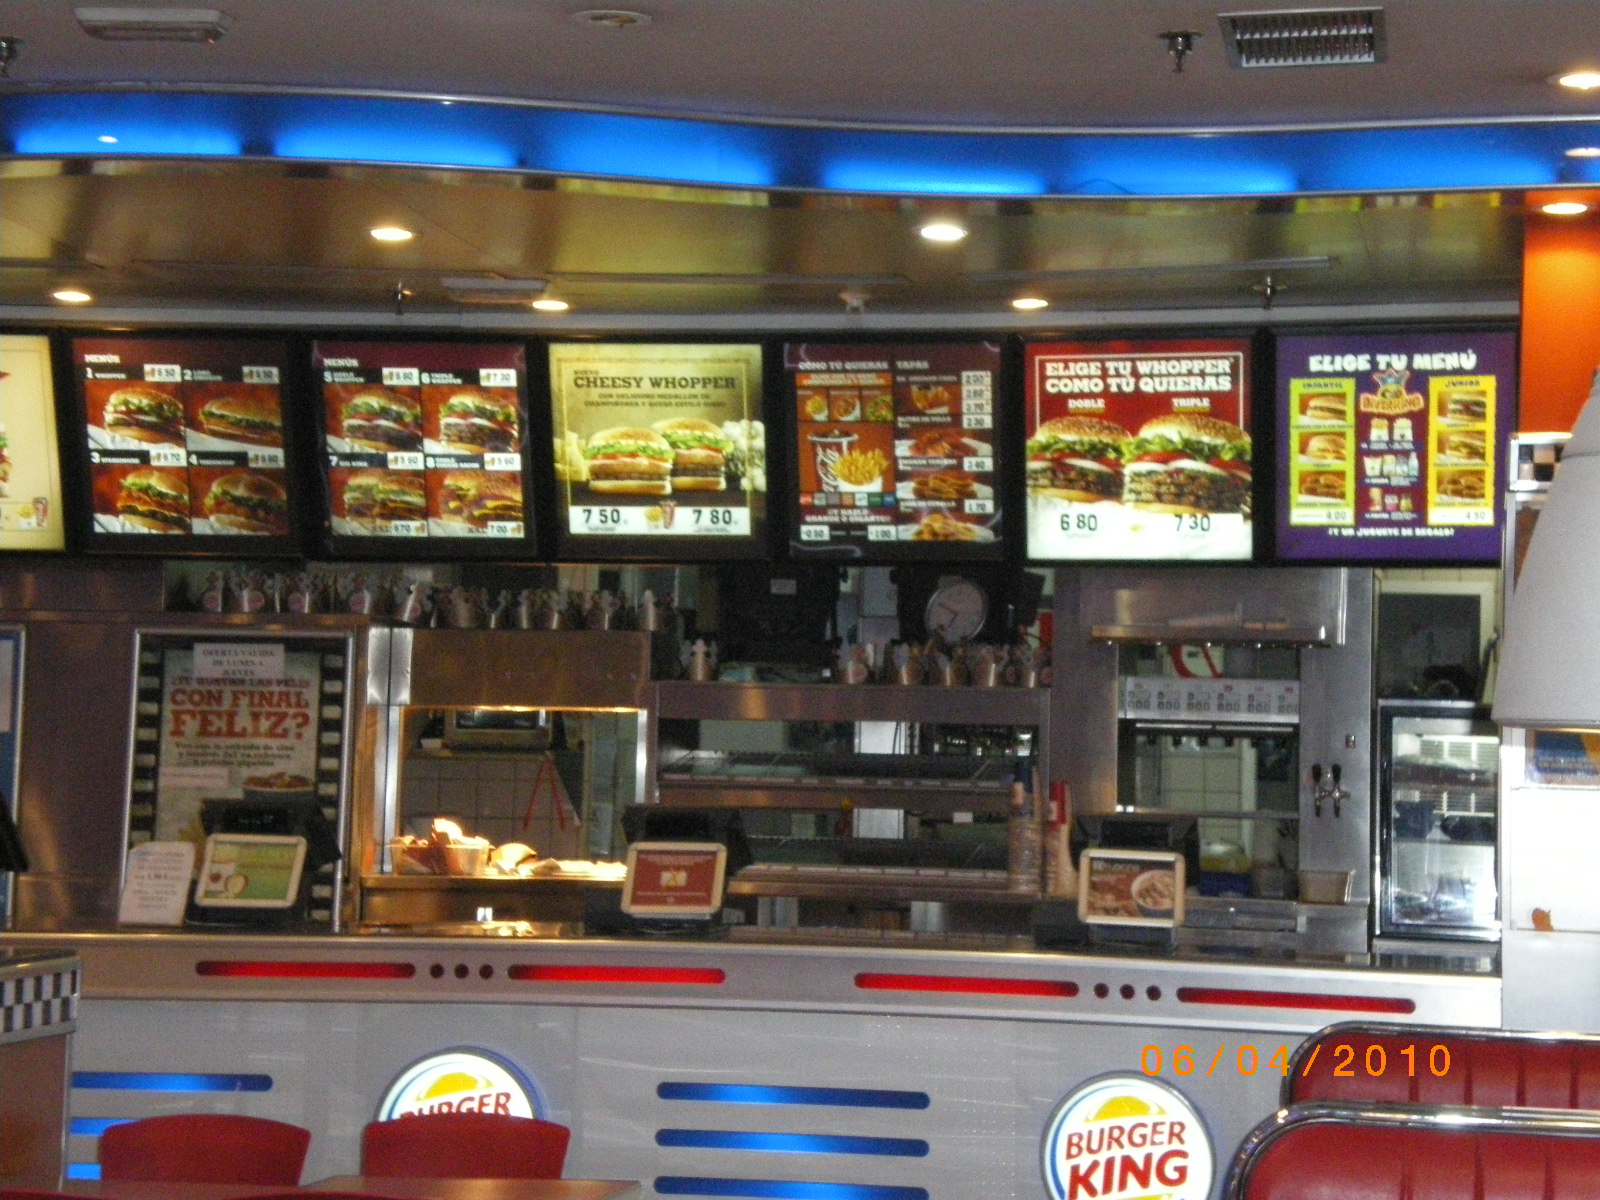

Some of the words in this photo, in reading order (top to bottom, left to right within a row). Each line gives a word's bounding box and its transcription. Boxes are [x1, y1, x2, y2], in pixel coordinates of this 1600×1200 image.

[1045, 362, 1102, 376] ELIGE
[1105, 361, 1132, 375] TU
[1136, 359, 1232, 375] WHOPPER
[1309, 354, 1371, 372] ELIGE
[1376, 353, 1408, 371] TU
[1413, 349, 1477, 371] MENÚ
[573, 376, 643, 389] CHEESY
[648, 376, 736, 389] WHOPPER
[1045, 378, 1104, 393] COMO
[1139, 376, 1232, 393] QUIERAS
[1068, 398, 1105, 409] DOBLE
[1172, 397, 1210, 408] TRIPLE
[90, 452, 101, 463] 3
[170, 688, 224, 707] CON
[231, 689, 310, 708] FINAL
[170, 710, 311, 740] FELIZ?
[1065, 1120, 1186, 1161] BURGER
[1067, 1149, 1190, 1200] KING
